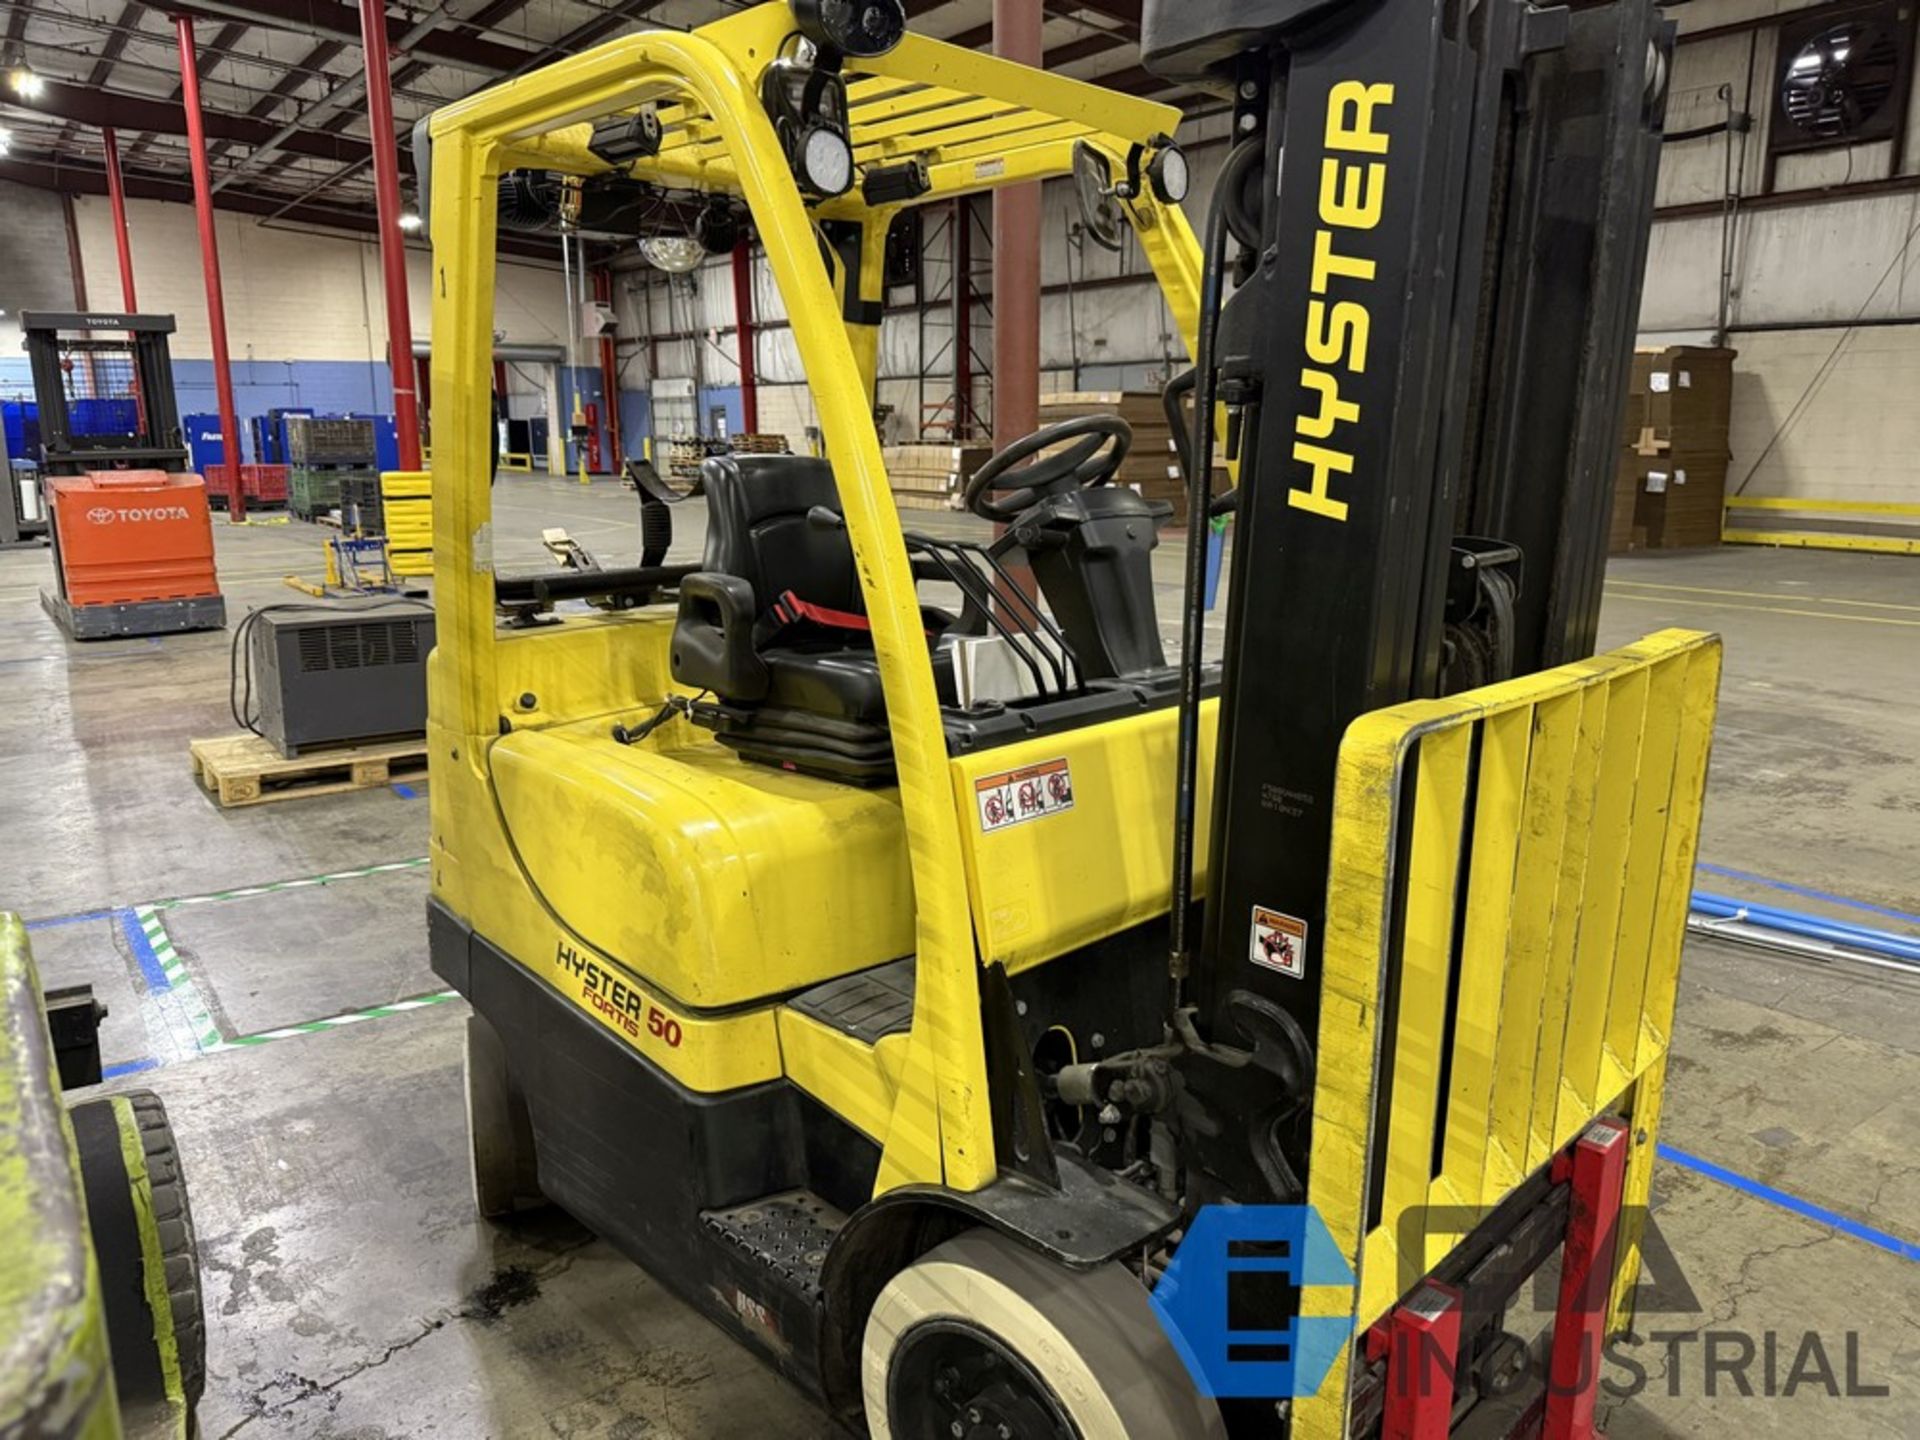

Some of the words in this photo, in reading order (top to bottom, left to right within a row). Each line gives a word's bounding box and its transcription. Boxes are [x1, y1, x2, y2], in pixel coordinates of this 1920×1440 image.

[1287, 79, 1395, 522] HYSTER
[116, 506, 190, 522] TOYOTA
[556, 940, 642, 1021] HYSTER
[647, 1005, 682, 1048] 50
[581, 985, 640, 1038] FORTIS
